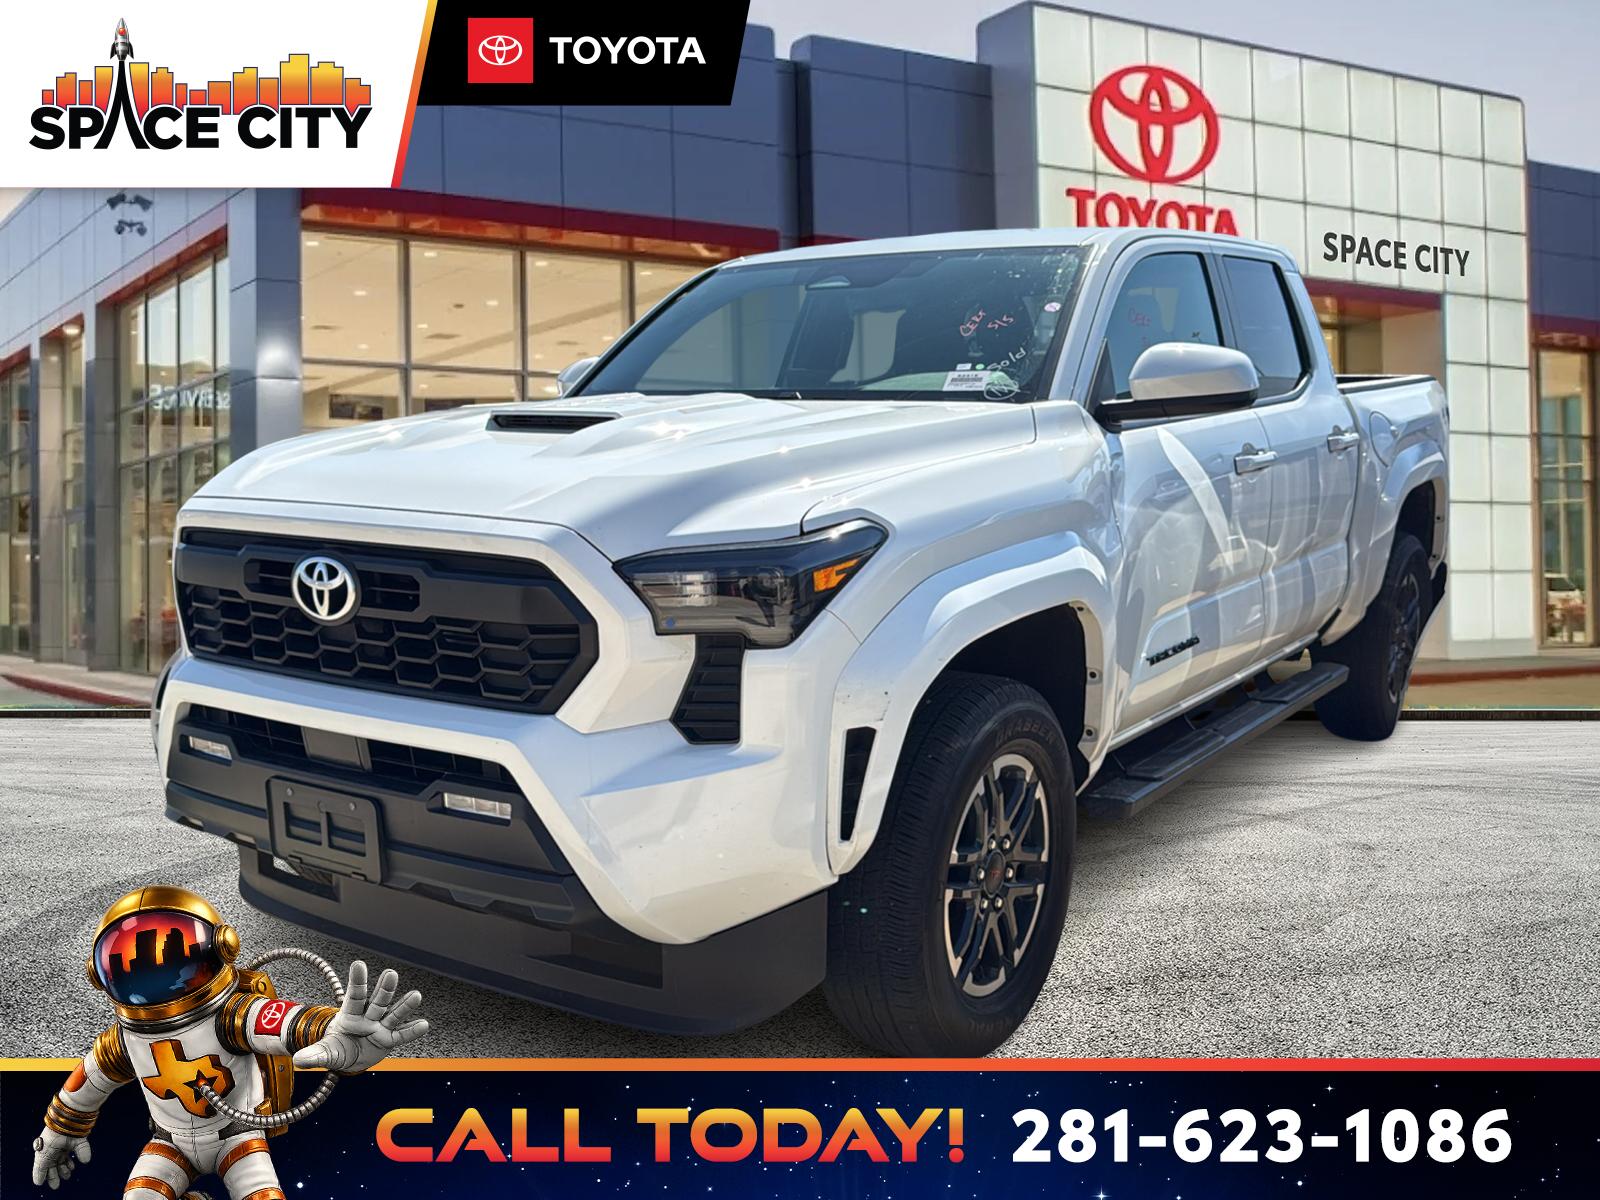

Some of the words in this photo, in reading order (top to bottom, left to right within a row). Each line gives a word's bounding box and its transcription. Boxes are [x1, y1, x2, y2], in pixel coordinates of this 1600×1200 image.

[1065, 188, 1238, 237] TOYOTA
[1323, 232, 1407, 270] SPACE
[1415, 244, 1470, 277] CITY
